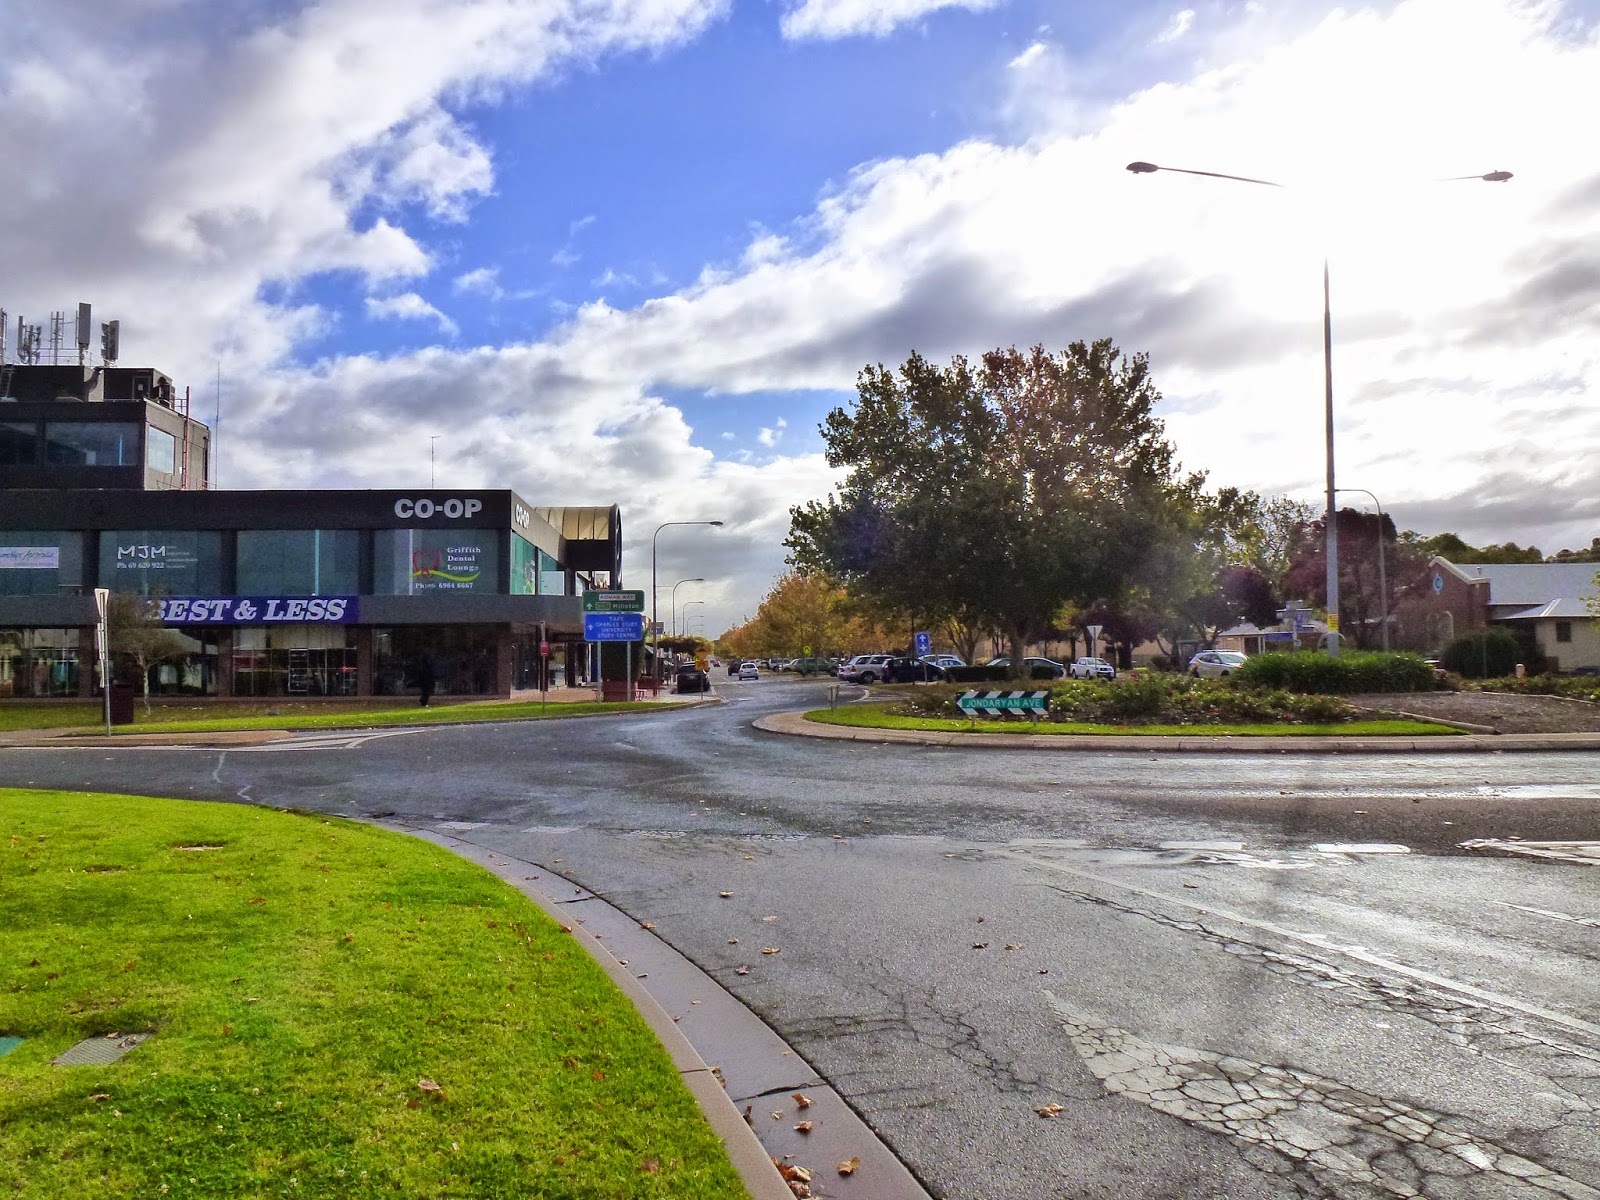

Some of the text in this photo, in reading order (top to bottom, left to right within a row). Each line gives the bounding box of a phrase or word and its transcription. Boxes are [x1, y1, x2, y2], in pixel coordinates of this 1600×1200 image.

[394, 498, 482, 518] CO-OP
[117, 545, 166, 560] MJM
[447, 564, 479, 572] Lounge
[234, 599, 258, 621] &
[263, 599, 347, 621] LESS
[965, 698, 1041, 708] JONDARYAN AVE
